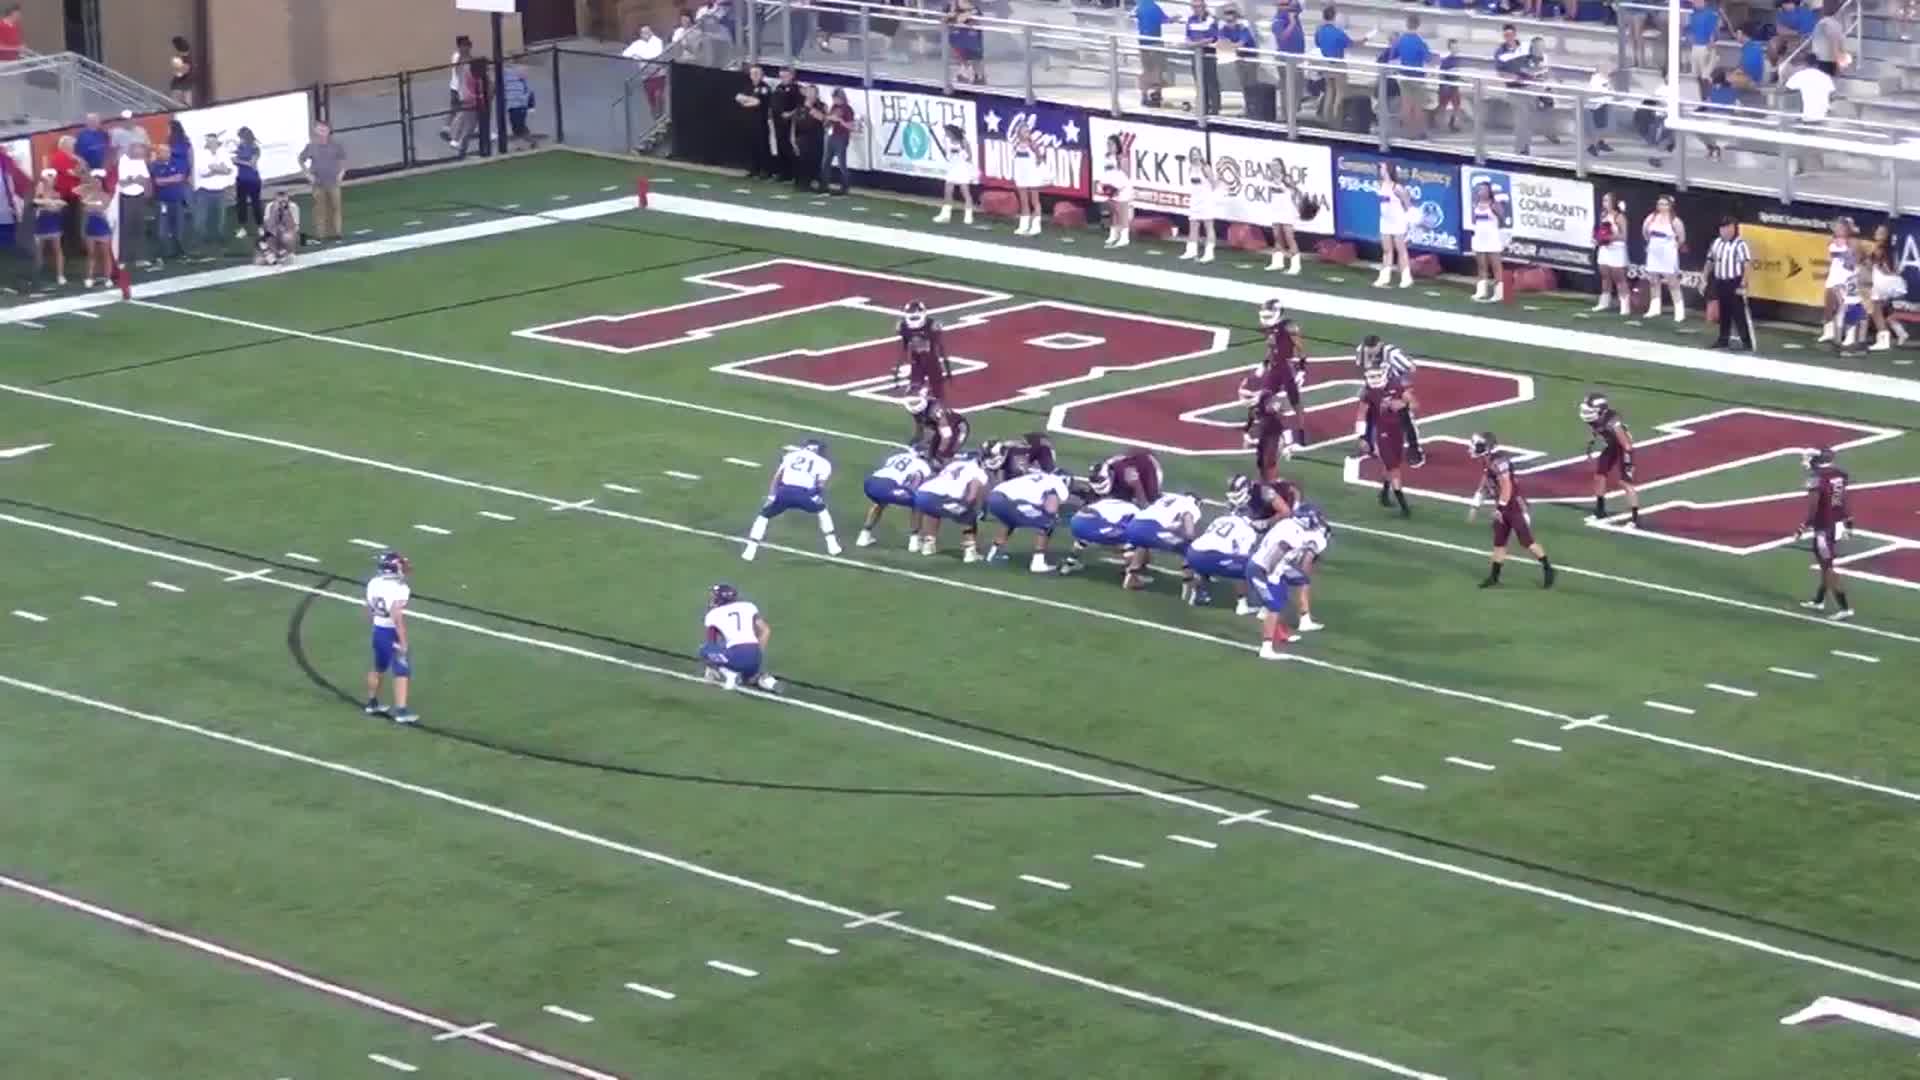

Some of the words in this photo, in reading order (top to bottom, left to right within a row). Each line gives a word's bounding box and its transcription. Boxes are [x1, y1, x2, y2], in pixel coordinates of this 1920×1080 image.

[881, 95, 965, 130] HEALTH
[883, 121, 950, 161] ZON
[1135, 148, 1186, 186] KKT
[1245, 159, 1283, 183] BAN
[789, 456, 815, 473] 21
[727, 611, 741, 632] 7
